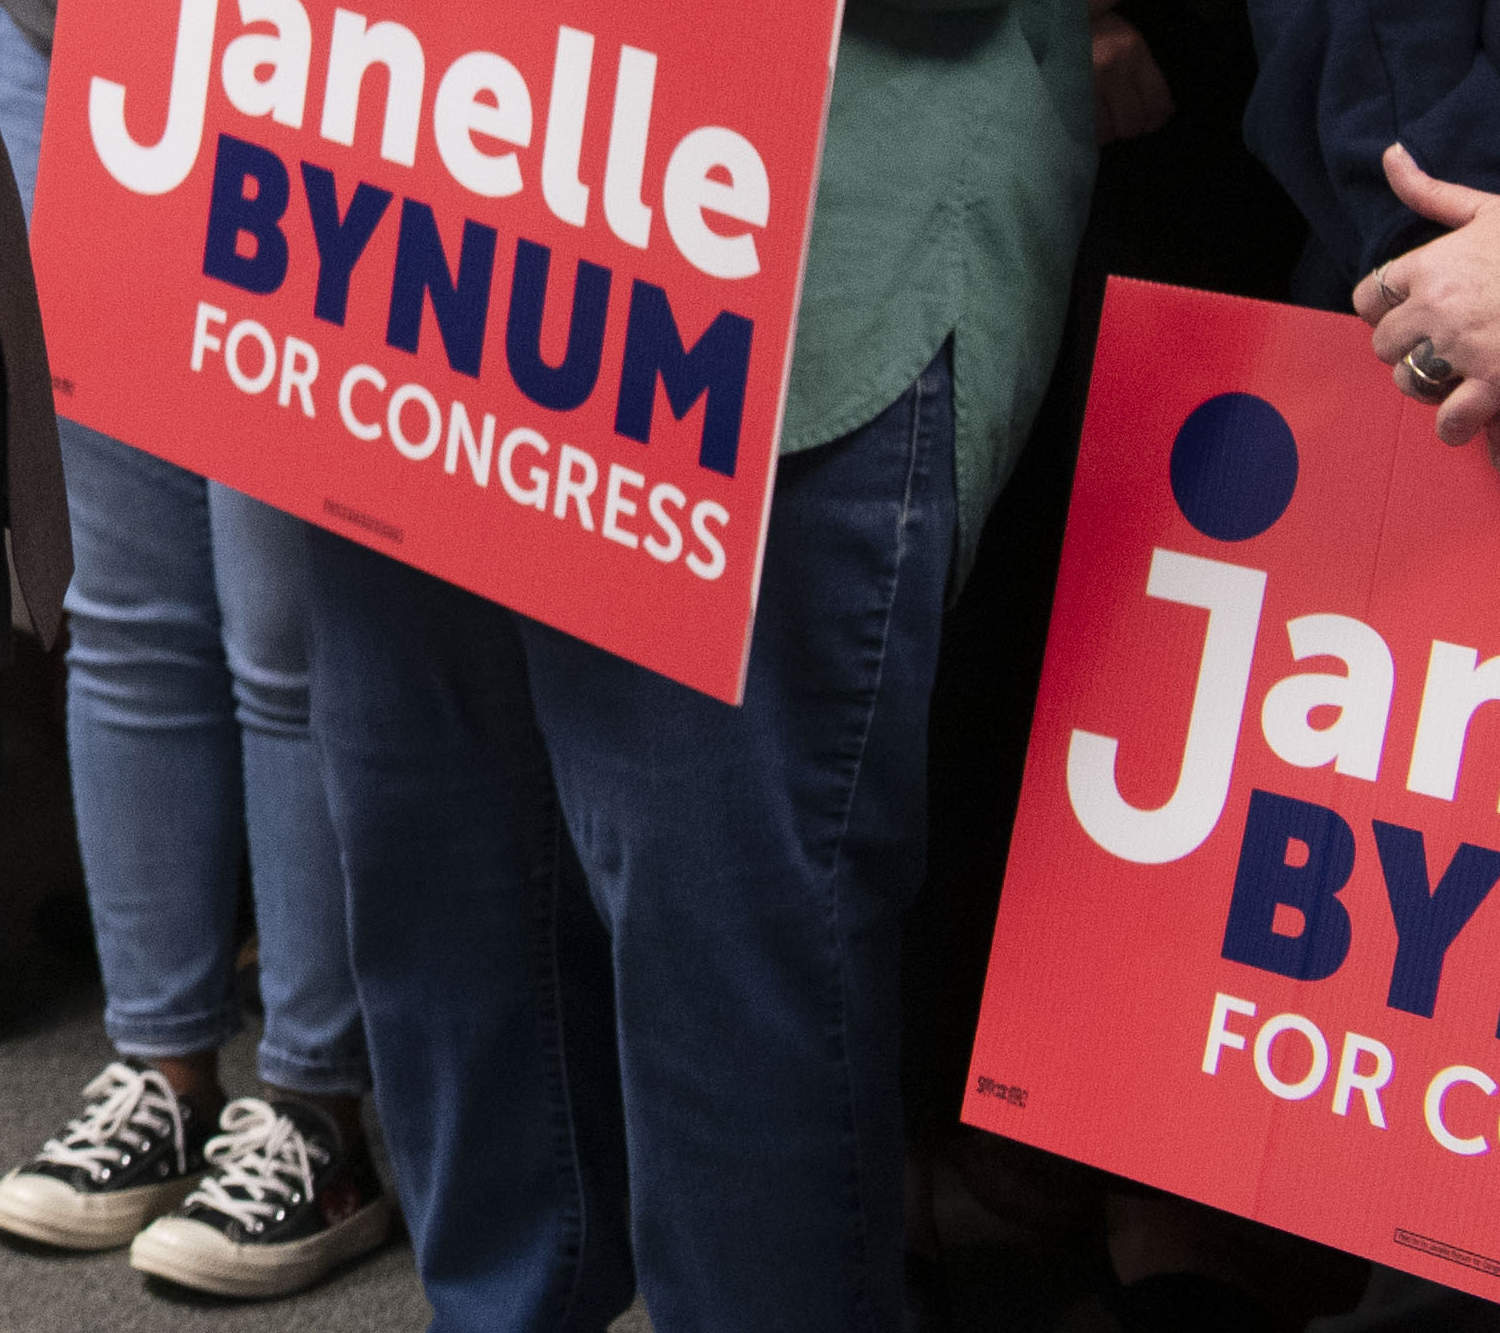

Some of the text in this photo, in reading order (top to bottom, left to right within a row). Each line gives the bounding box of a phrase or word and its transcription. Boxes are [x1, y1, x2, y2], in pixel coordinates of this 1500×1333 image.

[189, 301, 730, 581] FOR CONGRESS
[202, 133, 754, 479] BYNUM
[1201, 992, 1500, 1157] FOR C
